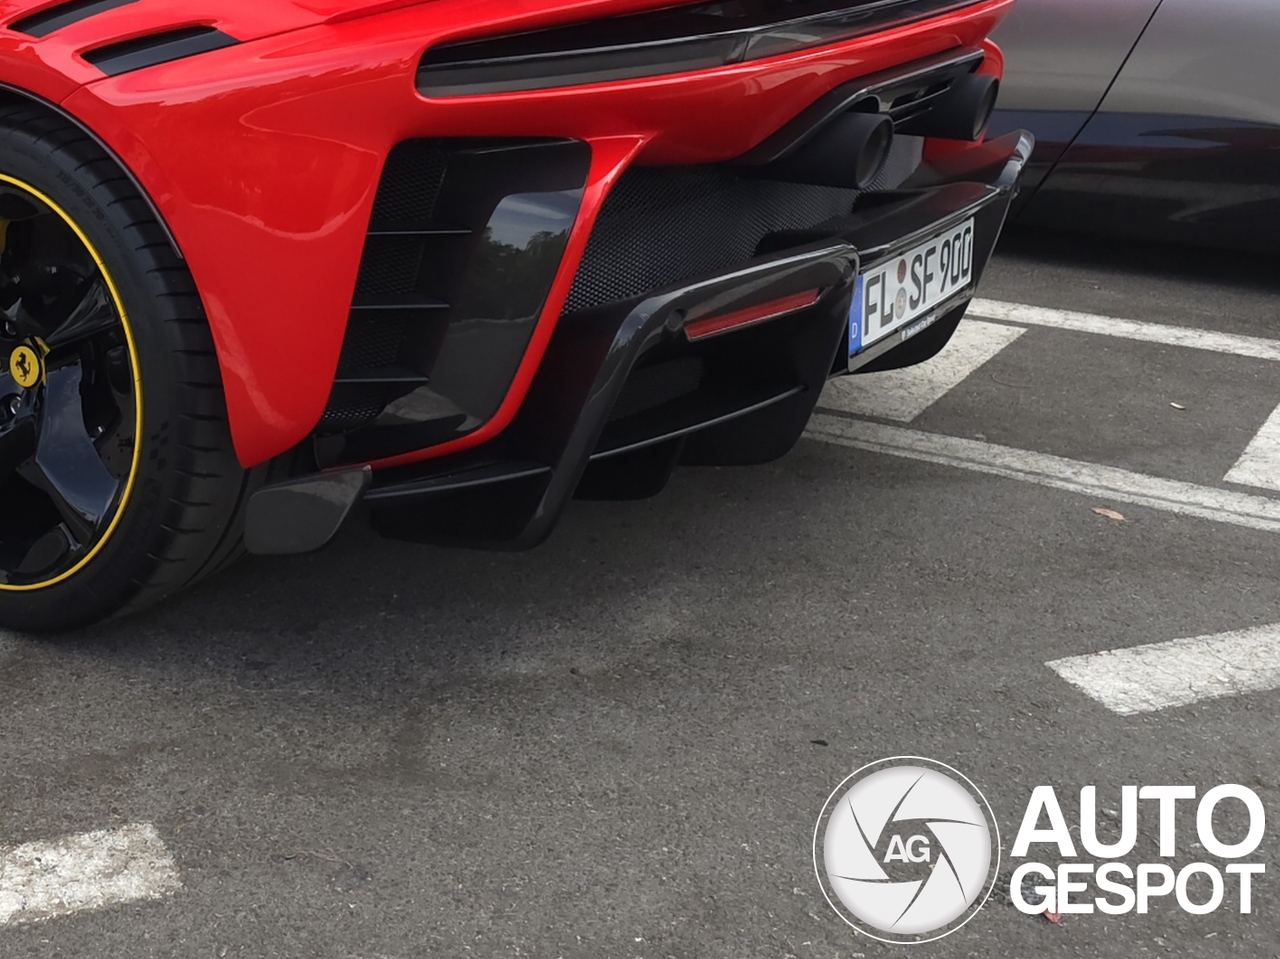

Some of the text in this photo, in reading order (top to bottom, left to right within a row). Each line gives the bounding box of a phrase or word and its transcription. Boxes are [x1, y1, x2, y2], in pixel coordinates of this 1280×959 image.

[864, 226, 972, 337] FL SF 900
[851, 322, 858, 339] D
